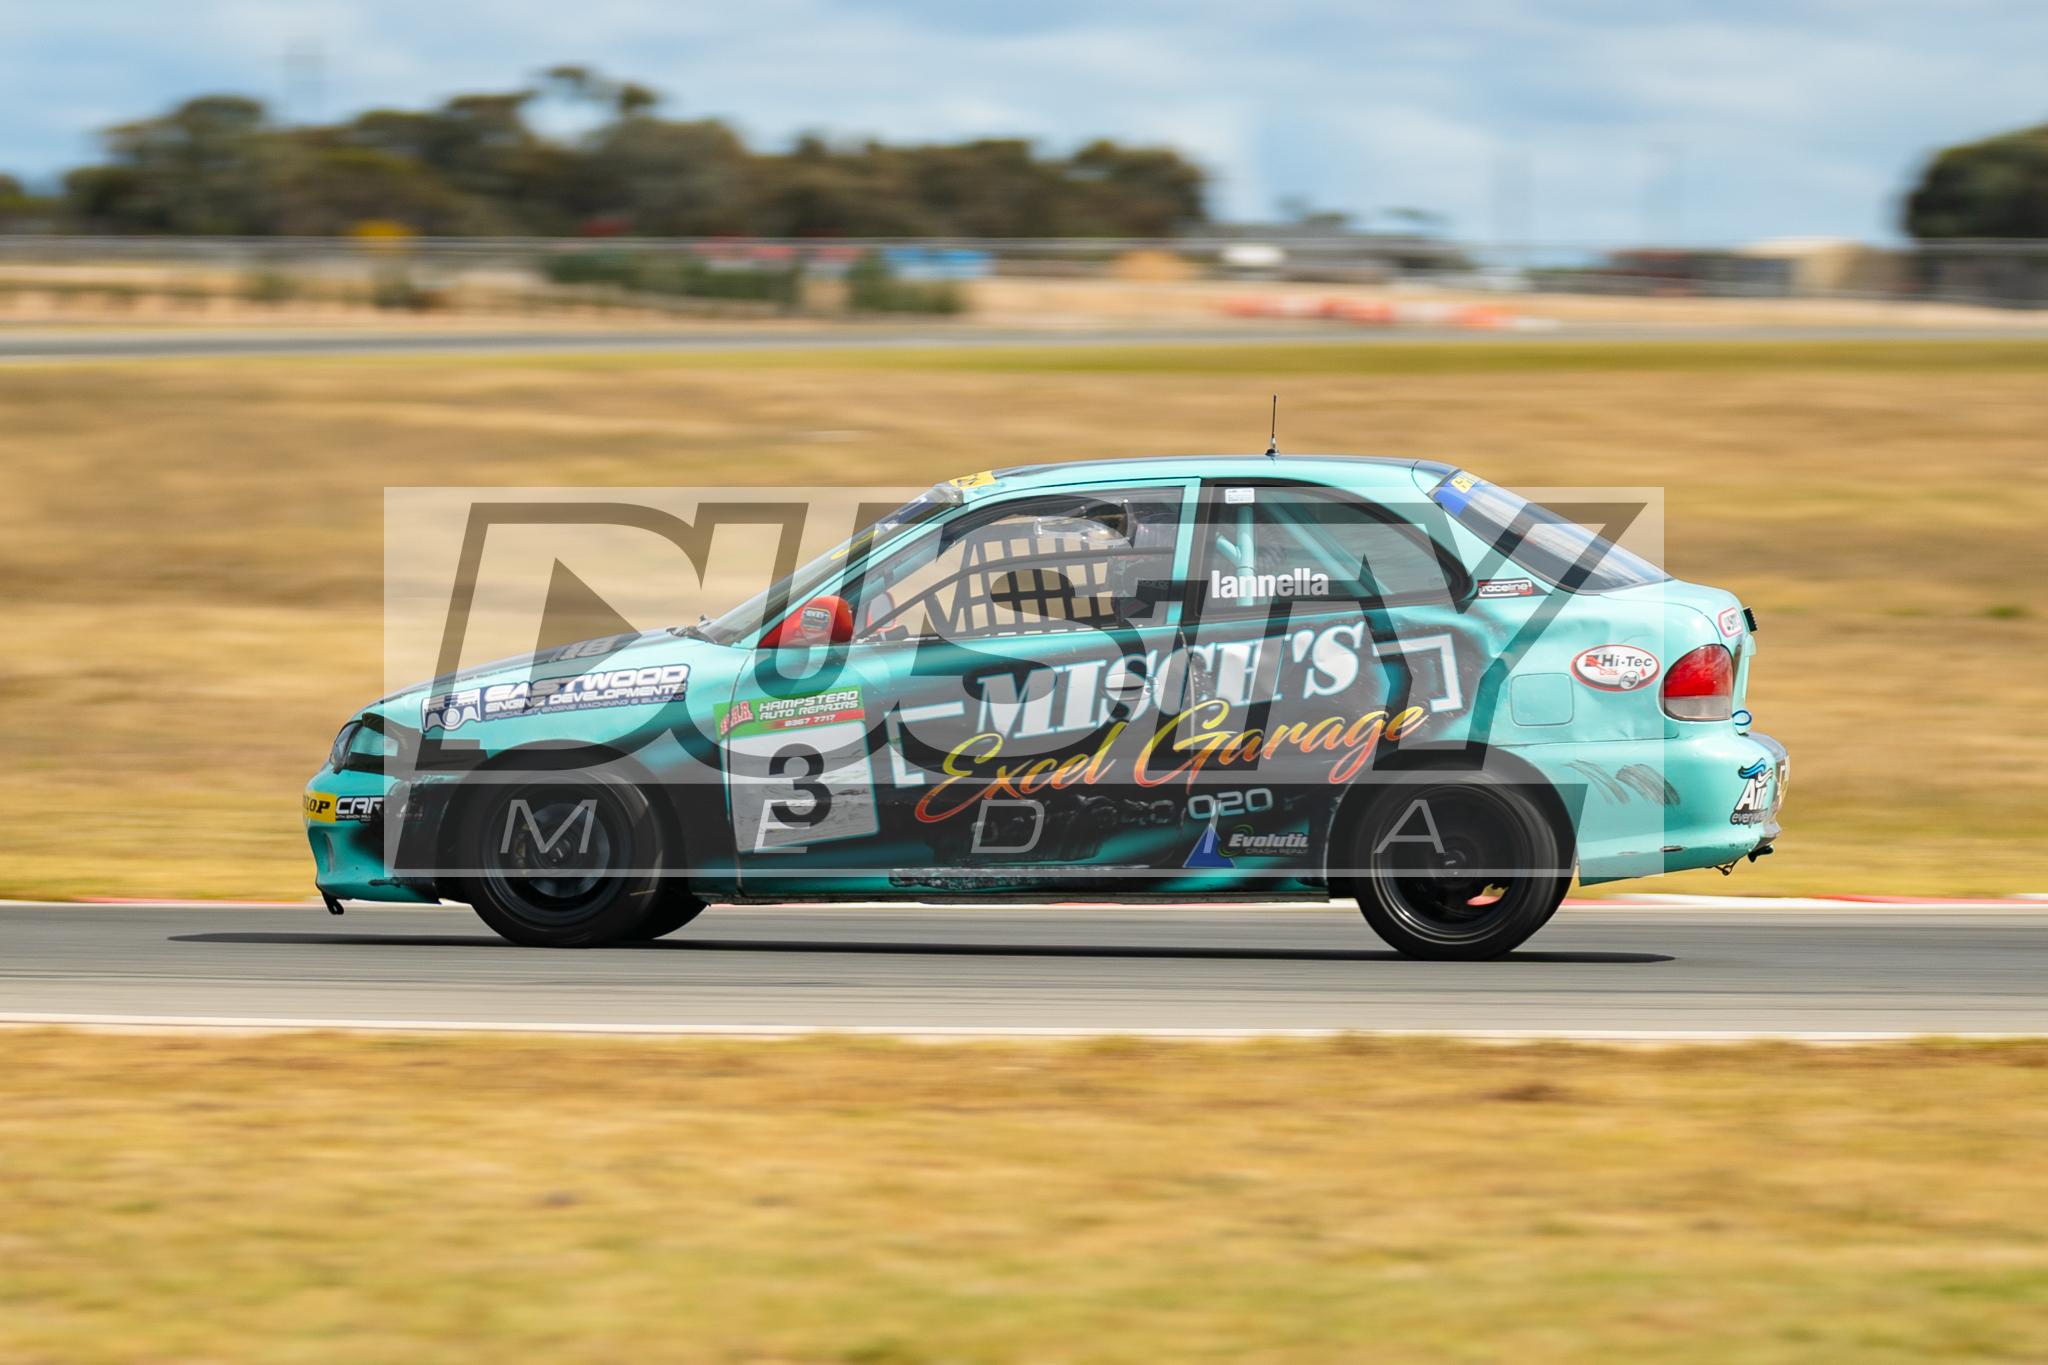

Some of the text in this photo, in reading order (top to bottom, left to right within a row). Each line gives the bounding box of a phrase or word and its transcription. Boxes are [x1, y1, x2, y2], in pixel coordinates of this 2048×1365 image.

[1211, 568, 1329, 598] Iannella
[1602, 654, 1653, 667] Hi-Tec
[484, 664, 690, 702] EASTWOOD
[976, 619, 1367, 740] MISCH'S
[485, 696, 546, 713] ENGINE
[549, 682, 686, 705] DEVELOPMENTS
[759, 690, 858, 712] HAMPSTEAD
[760, 700, 858, 720] AUTO REPAIRS
[914, 700, 1429, 823] Excel Garage
[769, 743, 832, 827] 3
